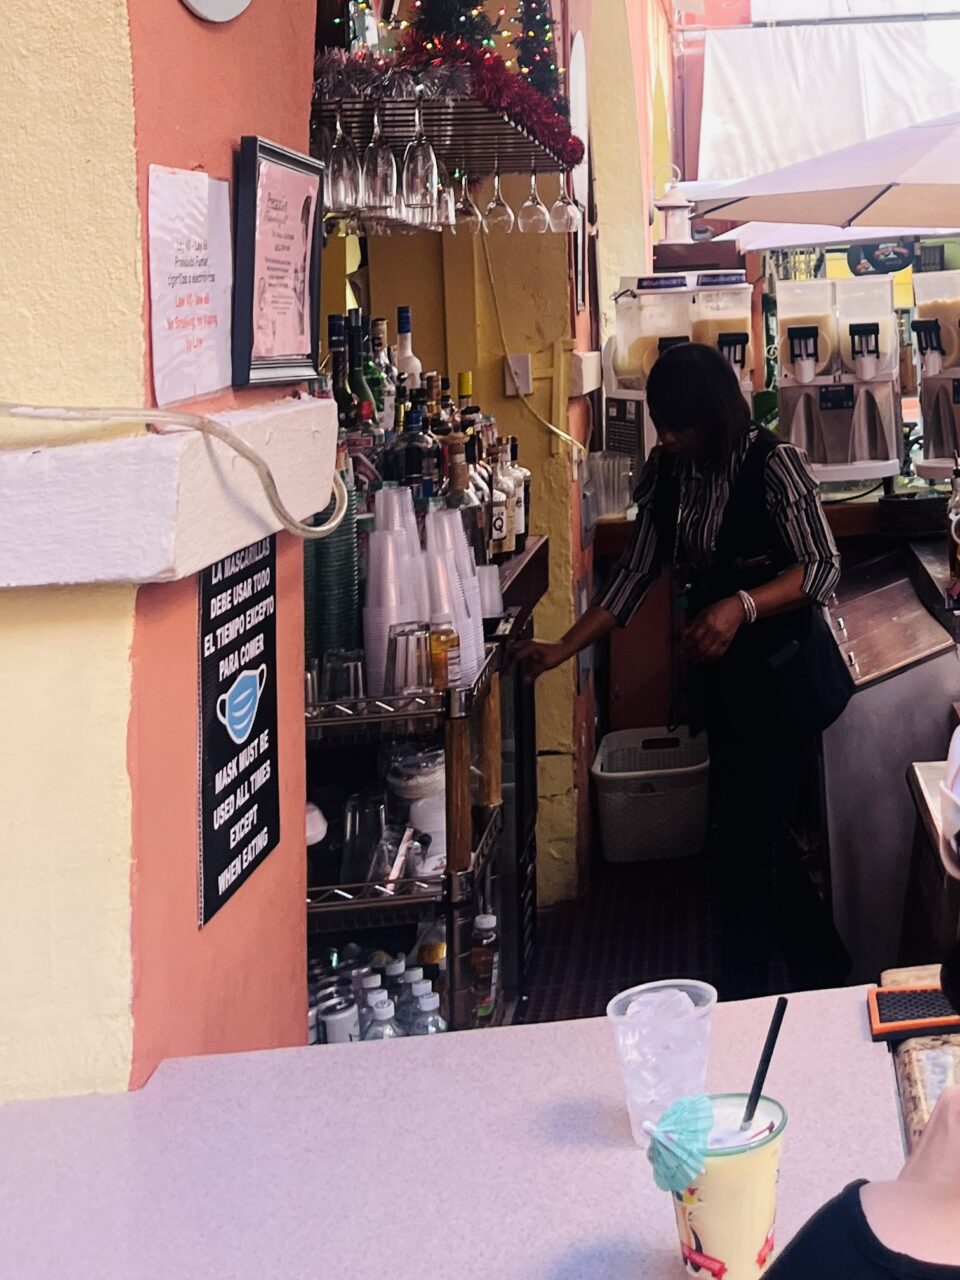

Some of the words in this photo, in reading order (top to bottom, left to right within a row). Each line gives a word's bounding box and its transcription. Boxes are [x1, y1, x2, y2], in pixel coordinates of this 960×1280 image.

[494, 517, 503, 533] Q
[210, 588, 232, 619] DEBE
[233, 577, 252, 606] USAR
[253, 567, 270, 593] TODO
[212, 561, 222, 585] LA
[204, 632, 215, 658] EL
[216, 614, 245, 649] TIEMPO
[246, 595, 274, 630] EXCEPTO
[219, 650, 239, 682] PARA
[240, 632, 264, 666] COMER
[215, 756, 238, 795] MASK
[239, 738, 259, 773] MUST
[260, 729, 269, 755] BE
[213, 794, 235, 830] USED
[236, 781, 250, 810] ALL
[250, 759, 271, 794] TIMES
[230, 804, 258, 850] EXCEPT
[218, 855, 241, 896] WHEN
[243, 826, 268, 870] EATING
